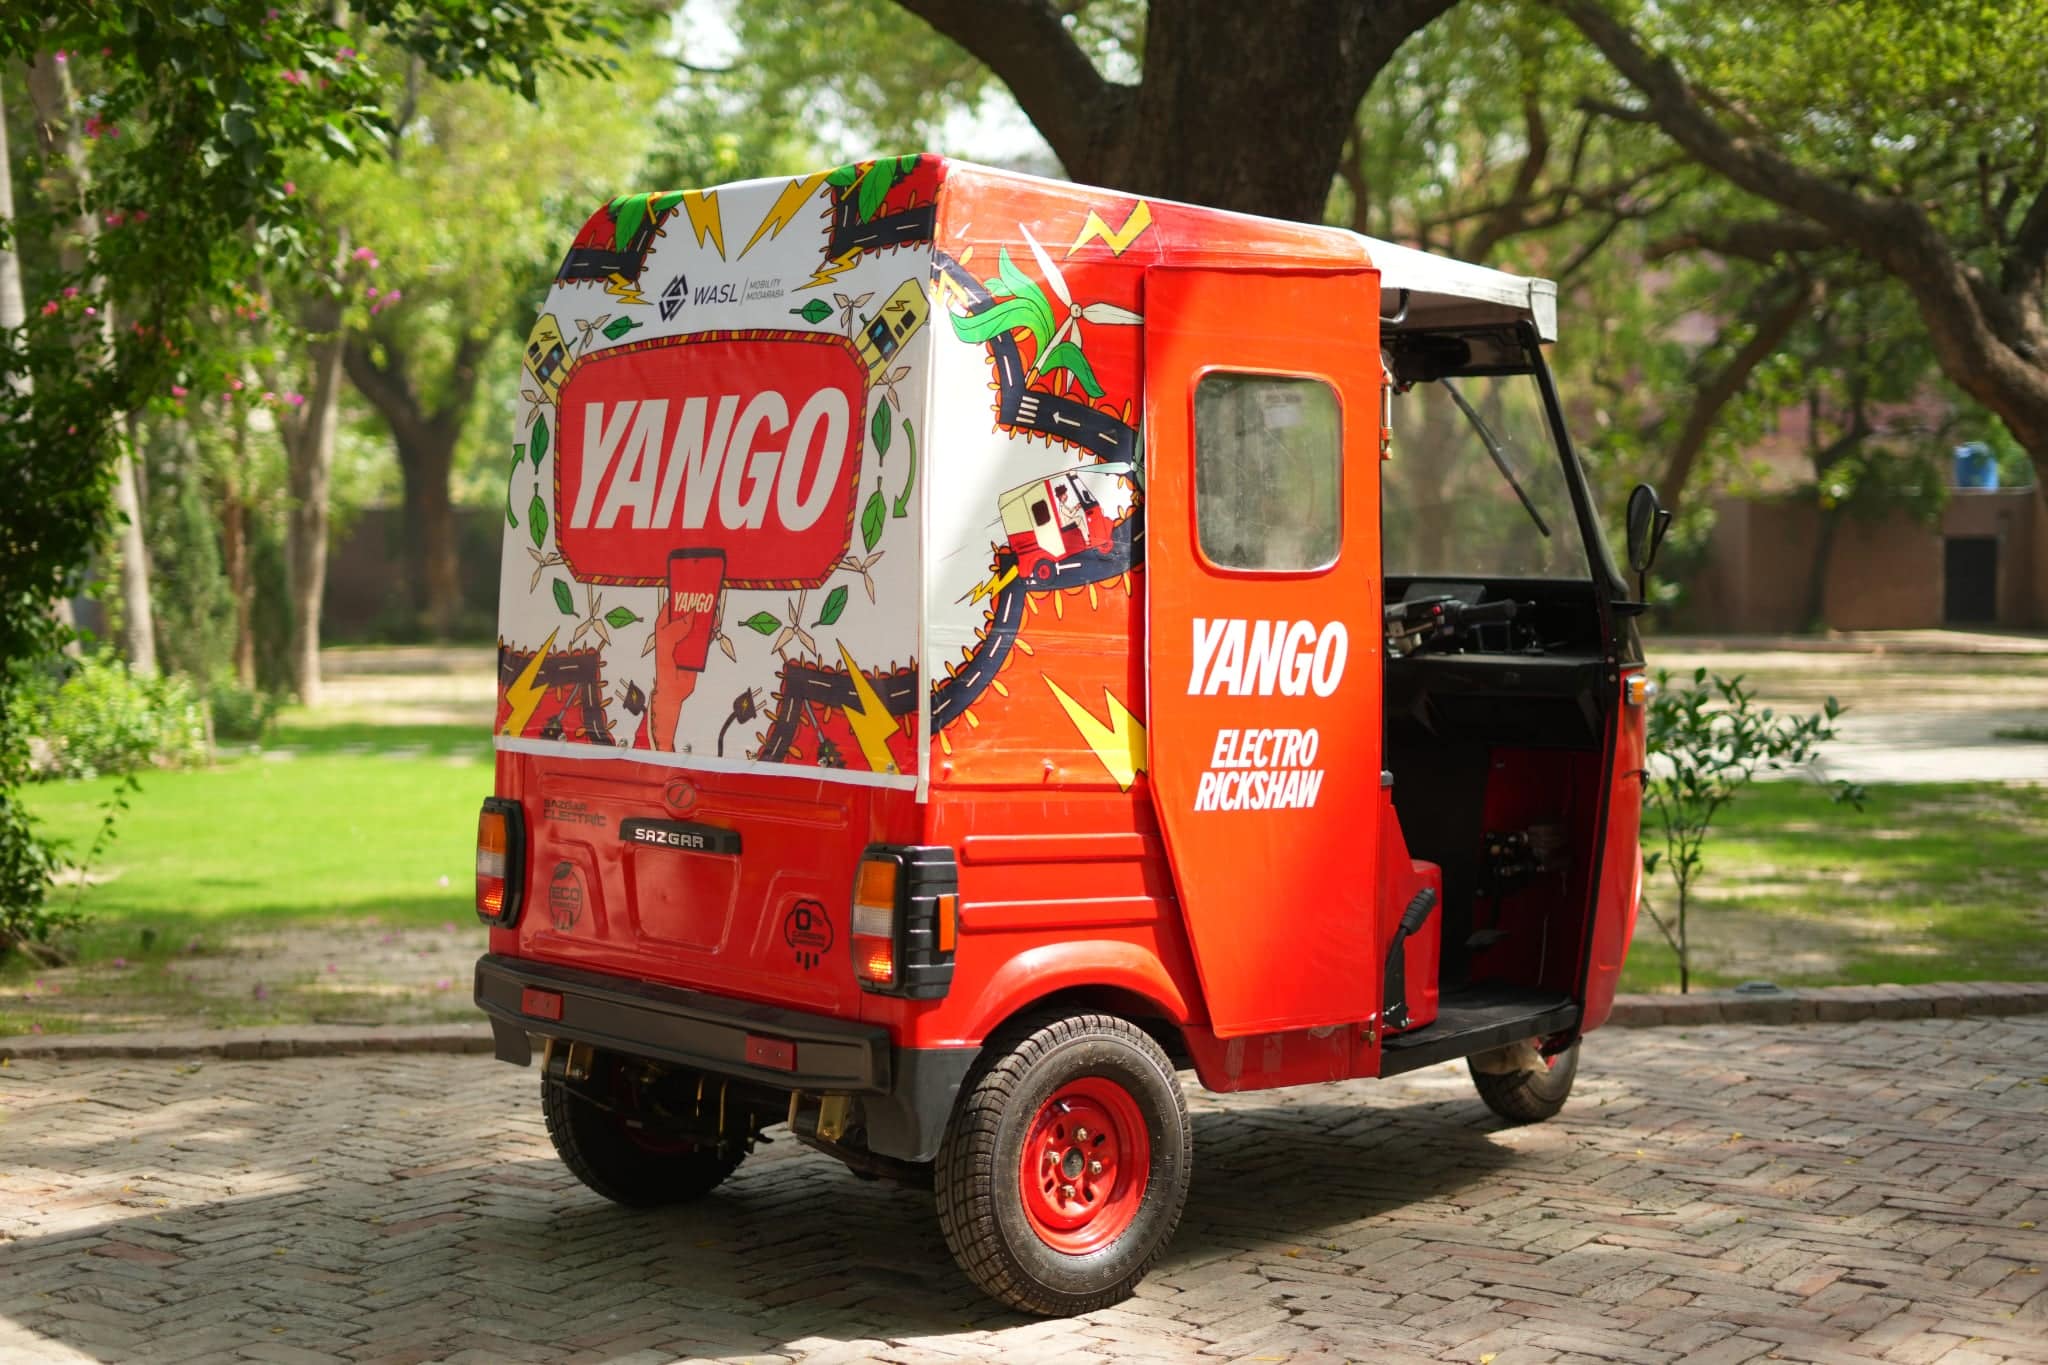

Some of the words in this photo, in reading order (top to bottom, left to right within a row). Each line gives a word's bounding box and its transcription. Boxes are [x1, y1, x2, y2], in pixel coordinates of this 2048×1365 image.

[693, 283, 738, 306] WASL
[749, 278, 782, 290] MOBILITY
[569, 387, 850, 531] YANGO
[674, 591, 714, 613] YANGO
[1187, 618, 1348, 697] YANGO
[1210, 728, 1319, 769] ELECTRO
[1194, 769, 1325, 811] RICKSHAW
[634, 828, 704, 848] SAZGAR
